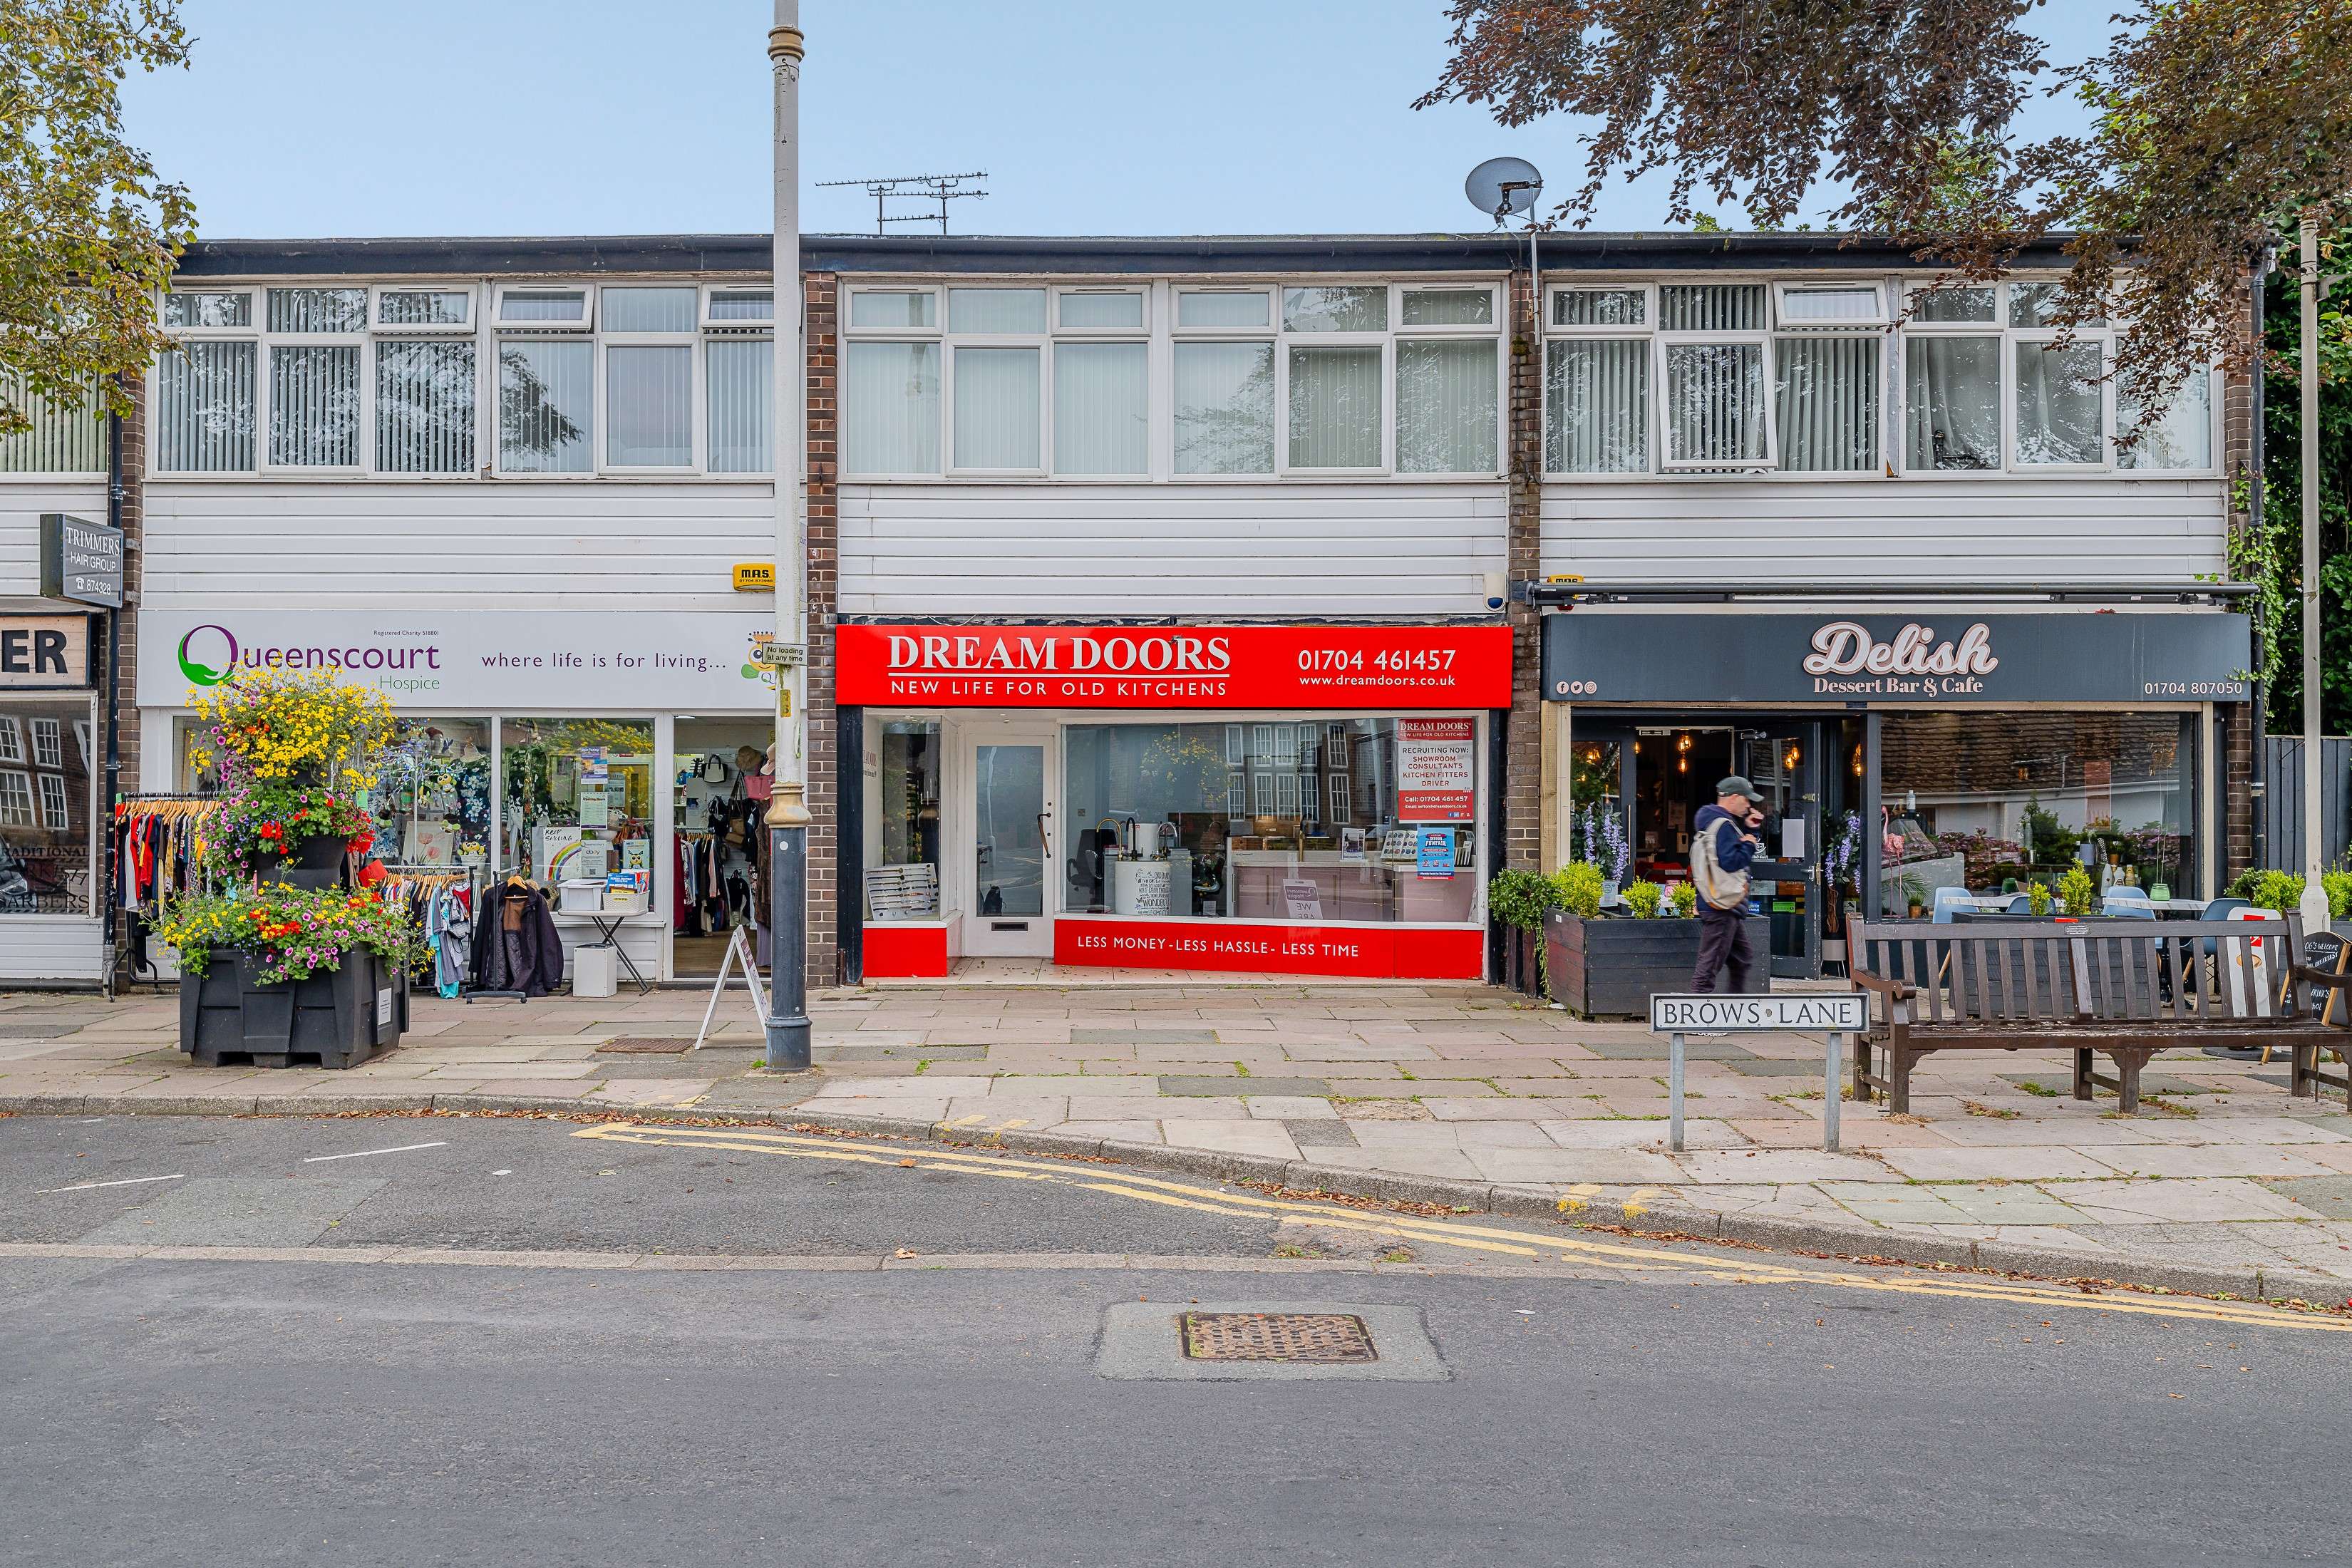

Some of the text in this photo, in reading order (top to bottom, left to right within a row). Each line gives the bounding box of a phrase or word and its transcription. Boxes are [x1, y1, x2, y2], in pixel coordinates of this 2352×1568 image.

[66, 527, 120, 556] TRIMMERS
[71, 551, 116, 572] HAIR GROUP
[86, 579, 111, 595] 874328
[887, 636, 1231, 671] DREAM DOORS
[1803, 621, 1998, 675] Delish
[178, 624, 440, 693] Queenscourt
[482, 652, 726, 672] where life is for living...
[1298, 649, 1456, 671] 01704 461457
[379, 676, 440, 693] Hospice
[891, 681, 1226, 696] NEW LIFE FOR OLD KITCHENS
[1299, 675, 1455, 686] www.dreamdoors.co.uk
[1813, 677, 1983, 697] Dessert Bar & Cafe
[2145, 682, 2242, 694] 01704 807050
[1400, 722, 1435, 731] DREAM
[1078, 936, 1107, 948] LESS
[1282, 943, 1315, 955] LESS
[1321, 944, 1359, 957] TIME
[2304, 942, 2318, 950] OG'S
[1664, 1002, 1852, 1024] BROWS LANE
